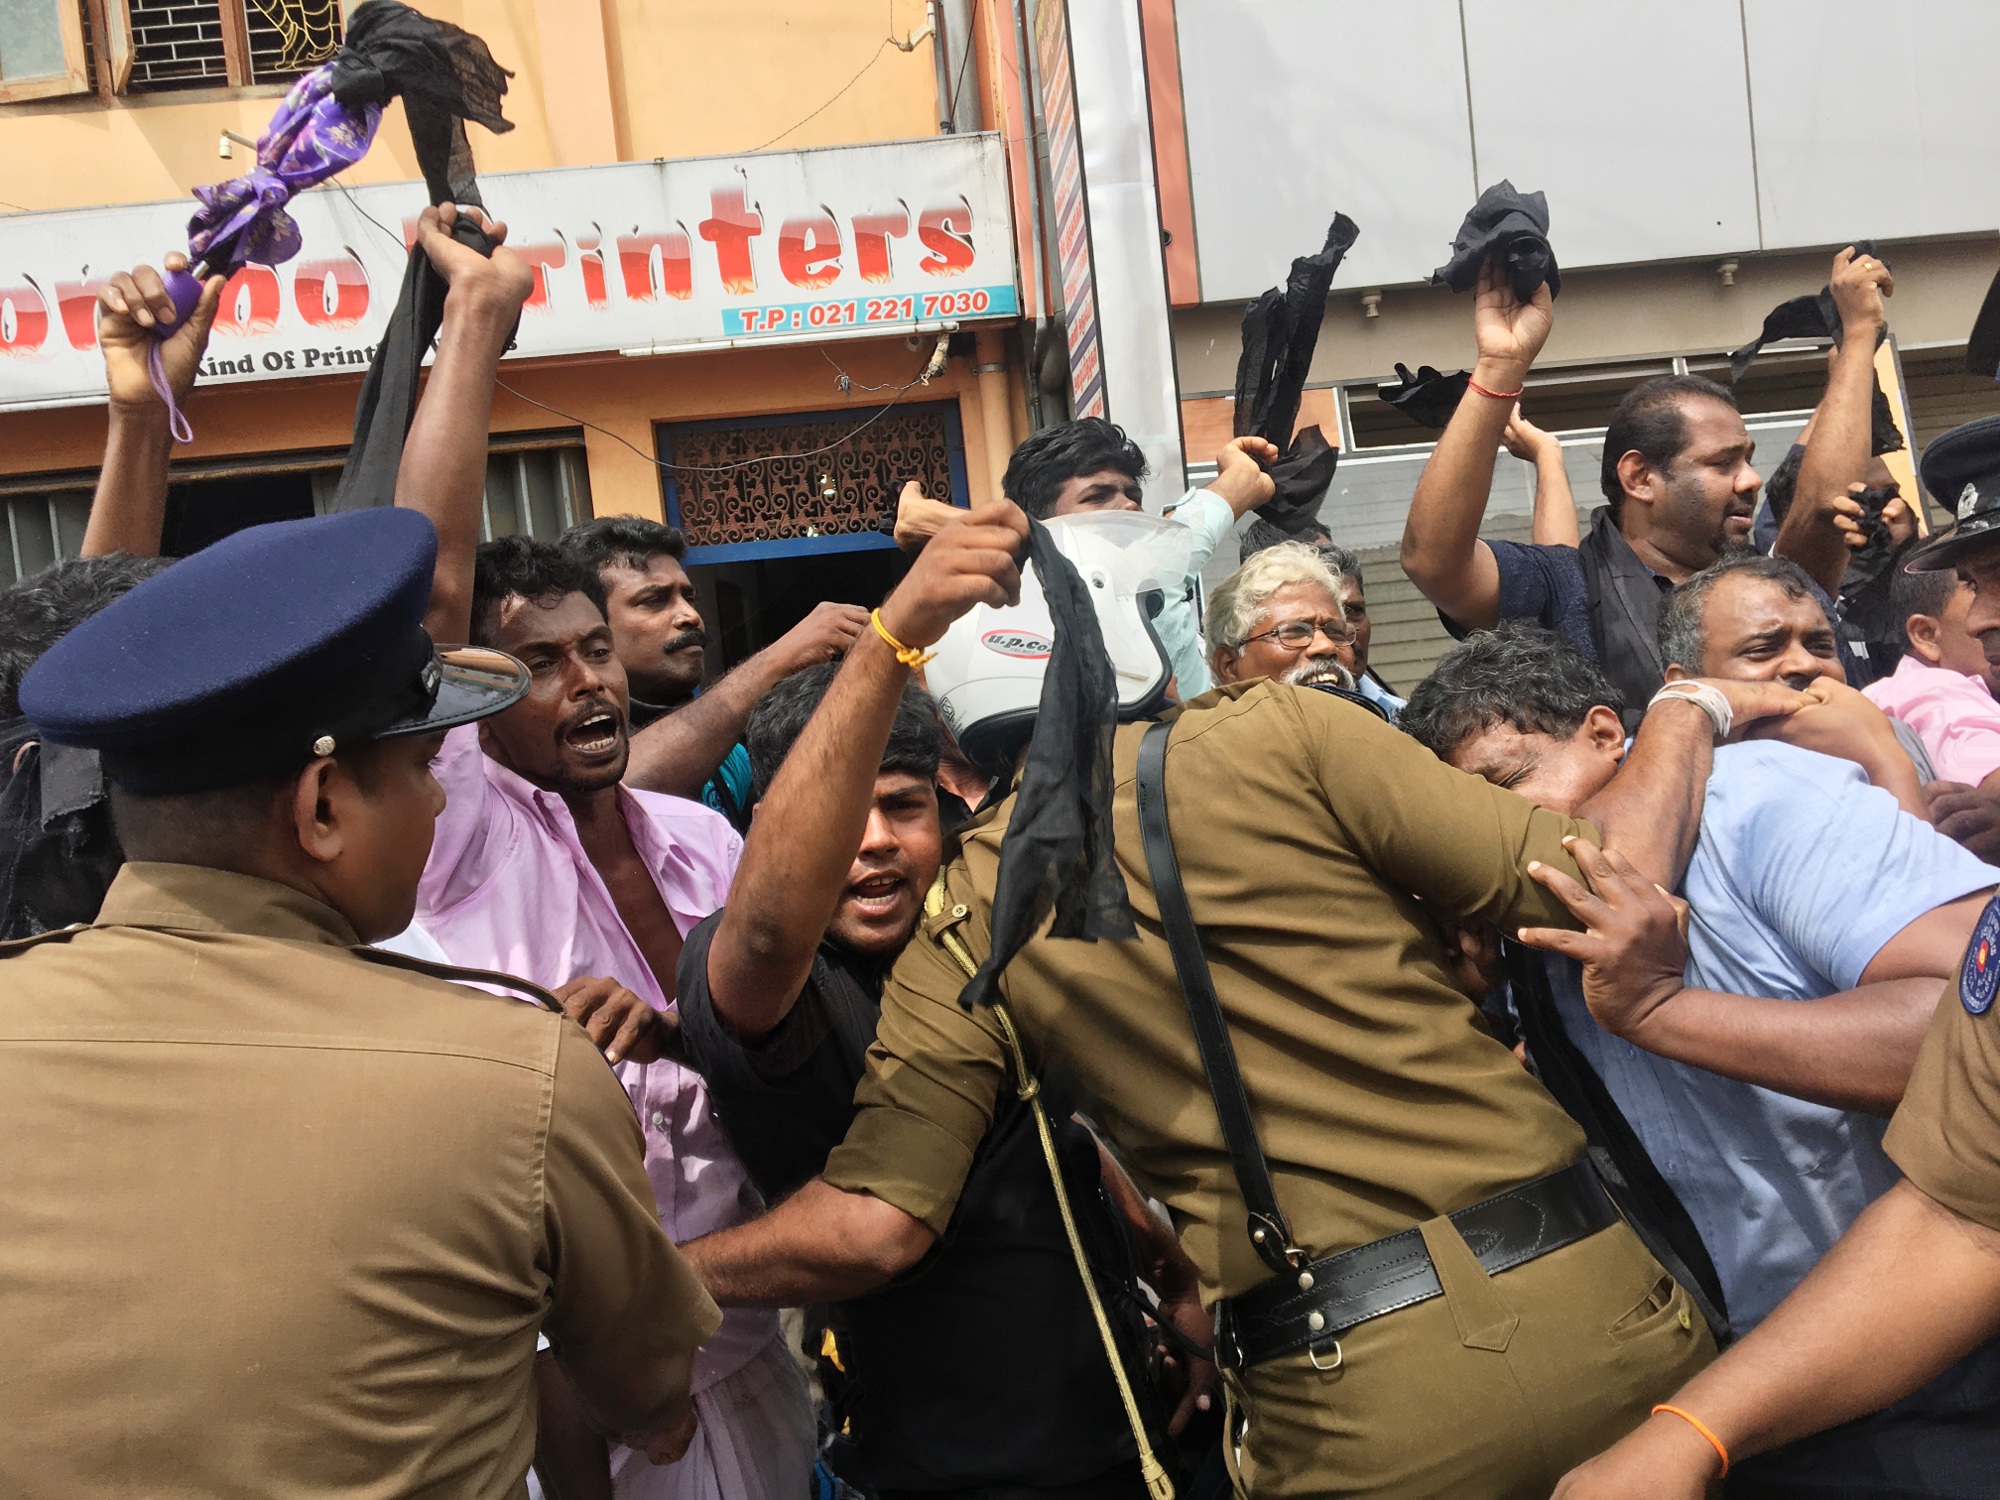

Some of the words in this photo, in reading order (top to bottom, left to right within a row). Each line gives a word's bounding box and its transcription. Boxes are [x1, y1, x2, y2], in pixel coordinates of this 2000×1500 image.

[402, 170, 976, 318] rinters
[809, 302, 855, 325] 021
[867, 297, 912, 321] 221
[924, 291, 988, 316] 7030
[263, 350, 295, 371] Of
[302, 343, 381, 368] Print
